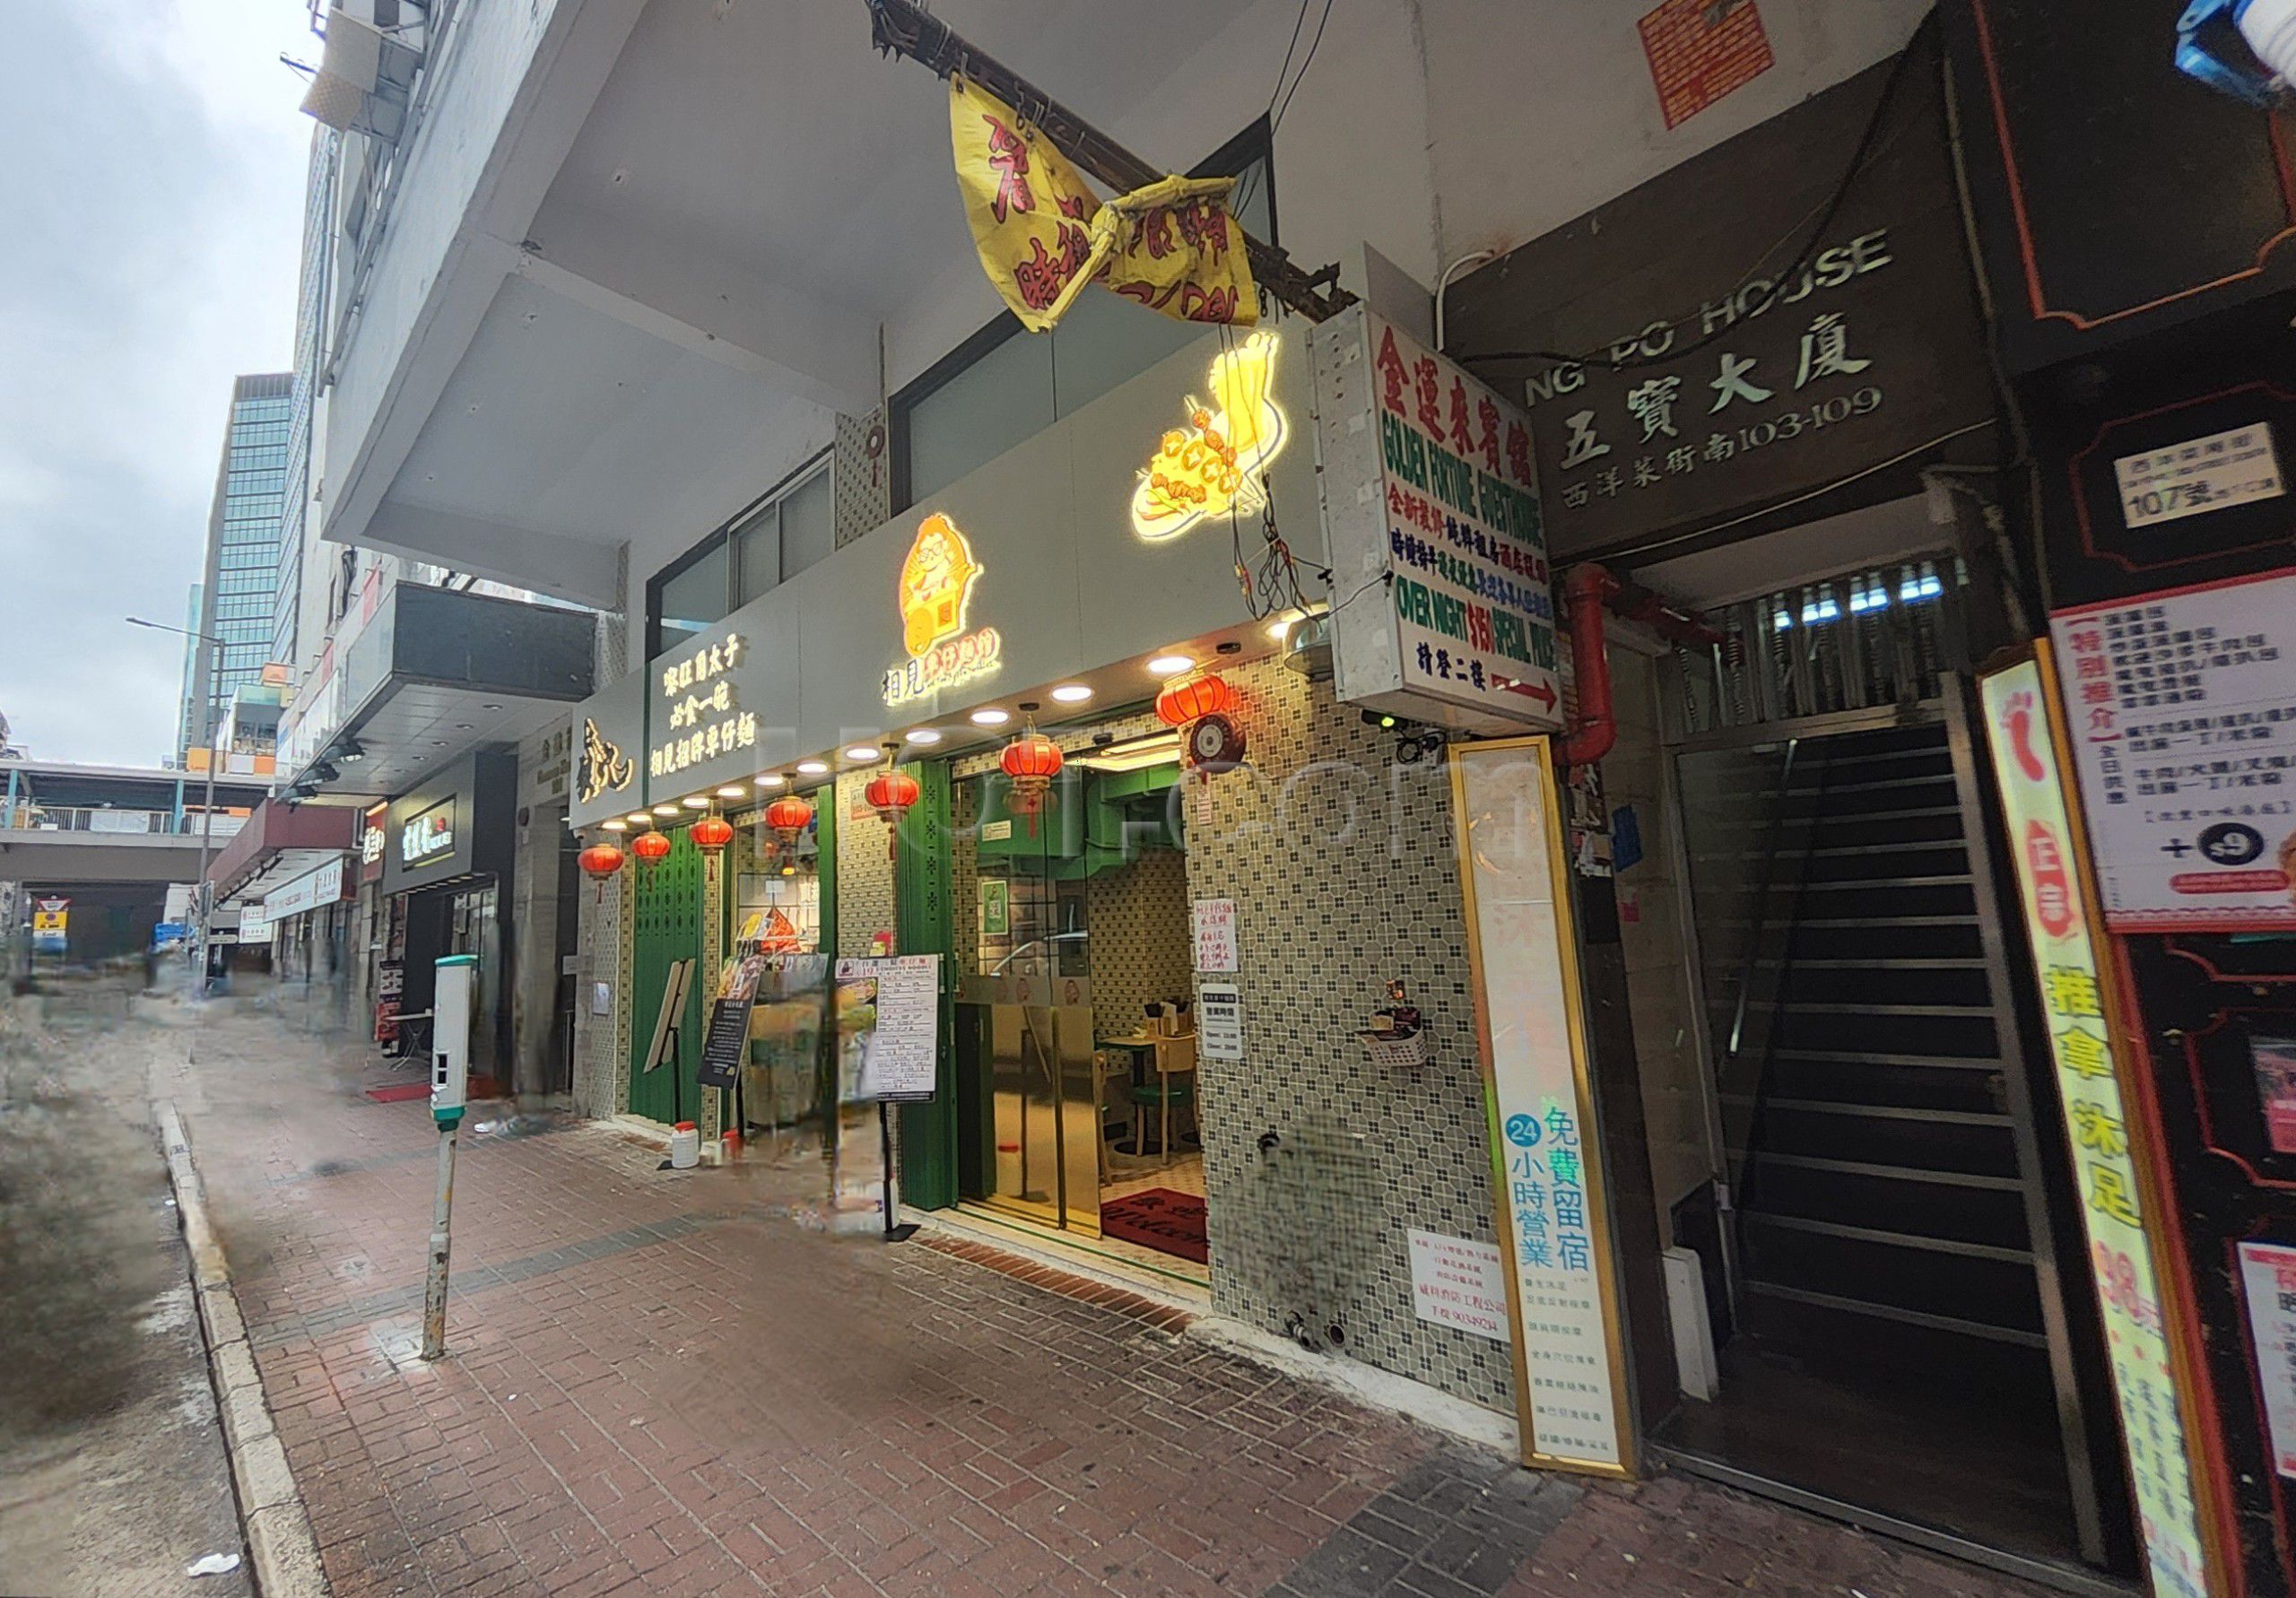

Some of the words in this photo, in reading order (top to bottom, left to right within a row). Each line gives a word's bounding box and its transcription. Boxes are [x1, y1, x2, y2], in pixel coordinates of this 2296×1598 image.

[1525, 360, 1585, 406] NG
[1560, 311, 1872, 470] 五寶大廈
[1396, 574, 1432, 630] OVER
[1431, 588, 1468, 643] NIGHT
[1510, 1120, 1537, 1142] 24
[1512, 1152, 1552, 1268] 小時營業
[1544, 1107, 1590, 1271] 免費留宿
